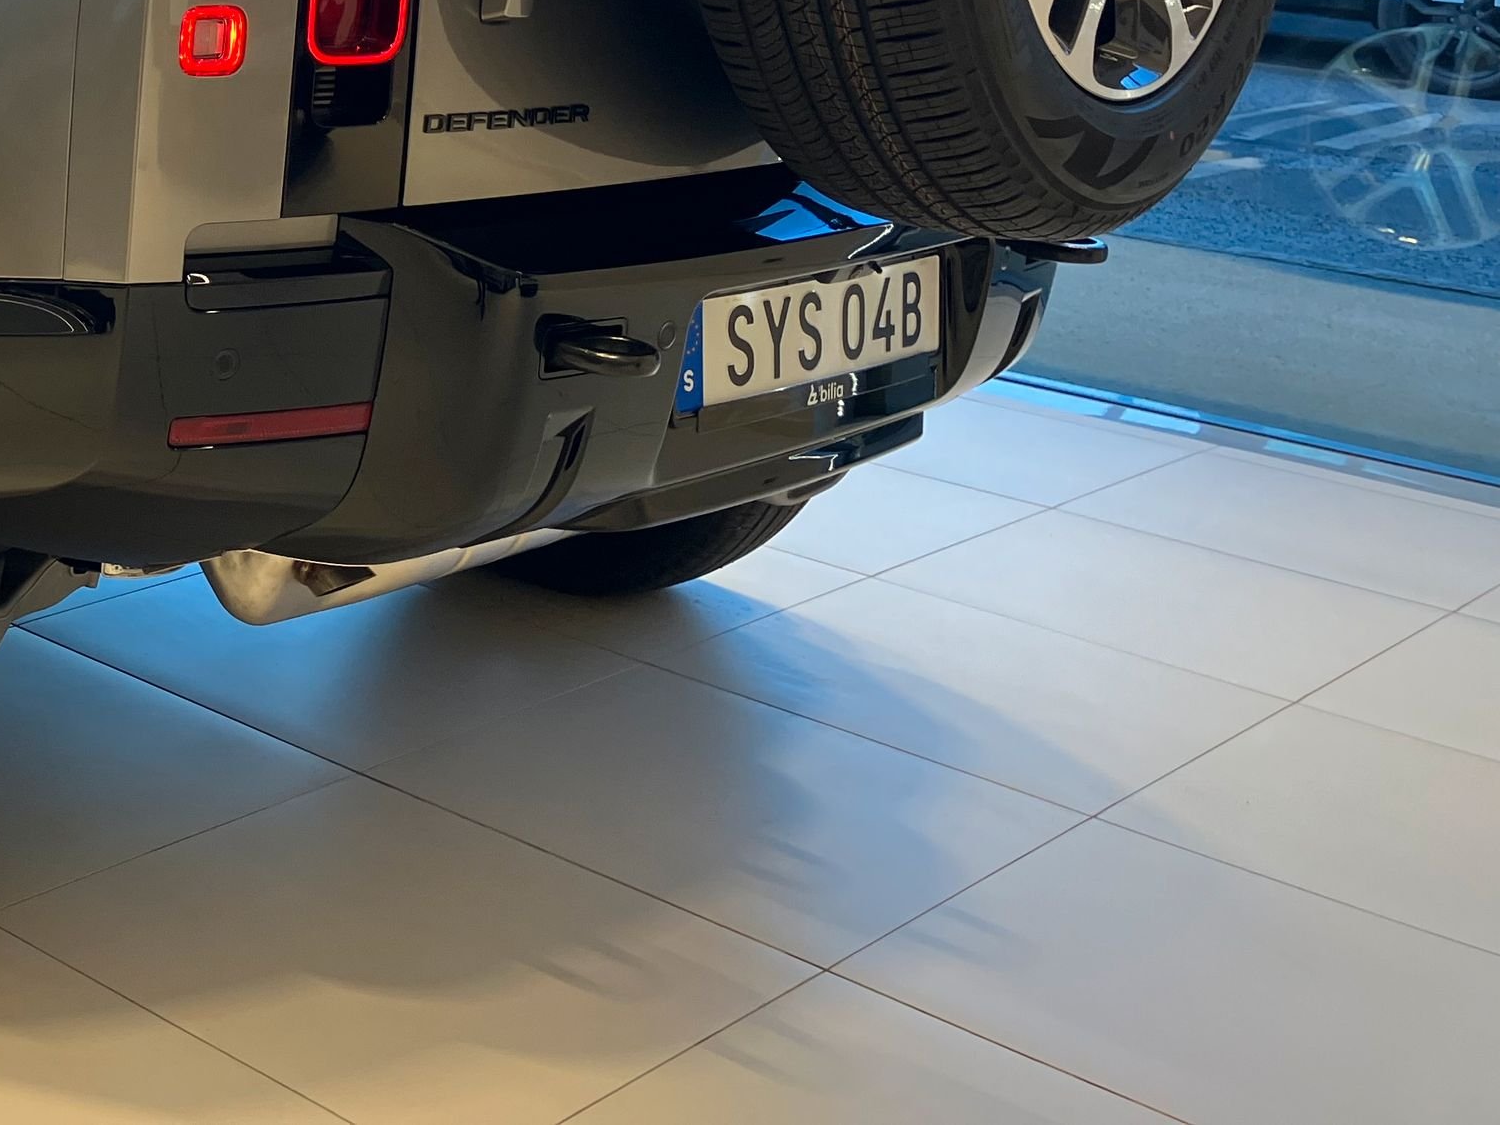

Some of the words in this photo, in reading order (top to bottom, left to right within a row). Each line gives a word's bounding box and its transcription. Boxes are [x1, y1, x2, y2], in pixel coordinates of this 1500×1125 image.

[422, 104, 590, 133] DEFENDER
[727, 291, 823, 386] SYS
[684, 369, 695, 392] S
[819, 382, 844, 402] bilia
